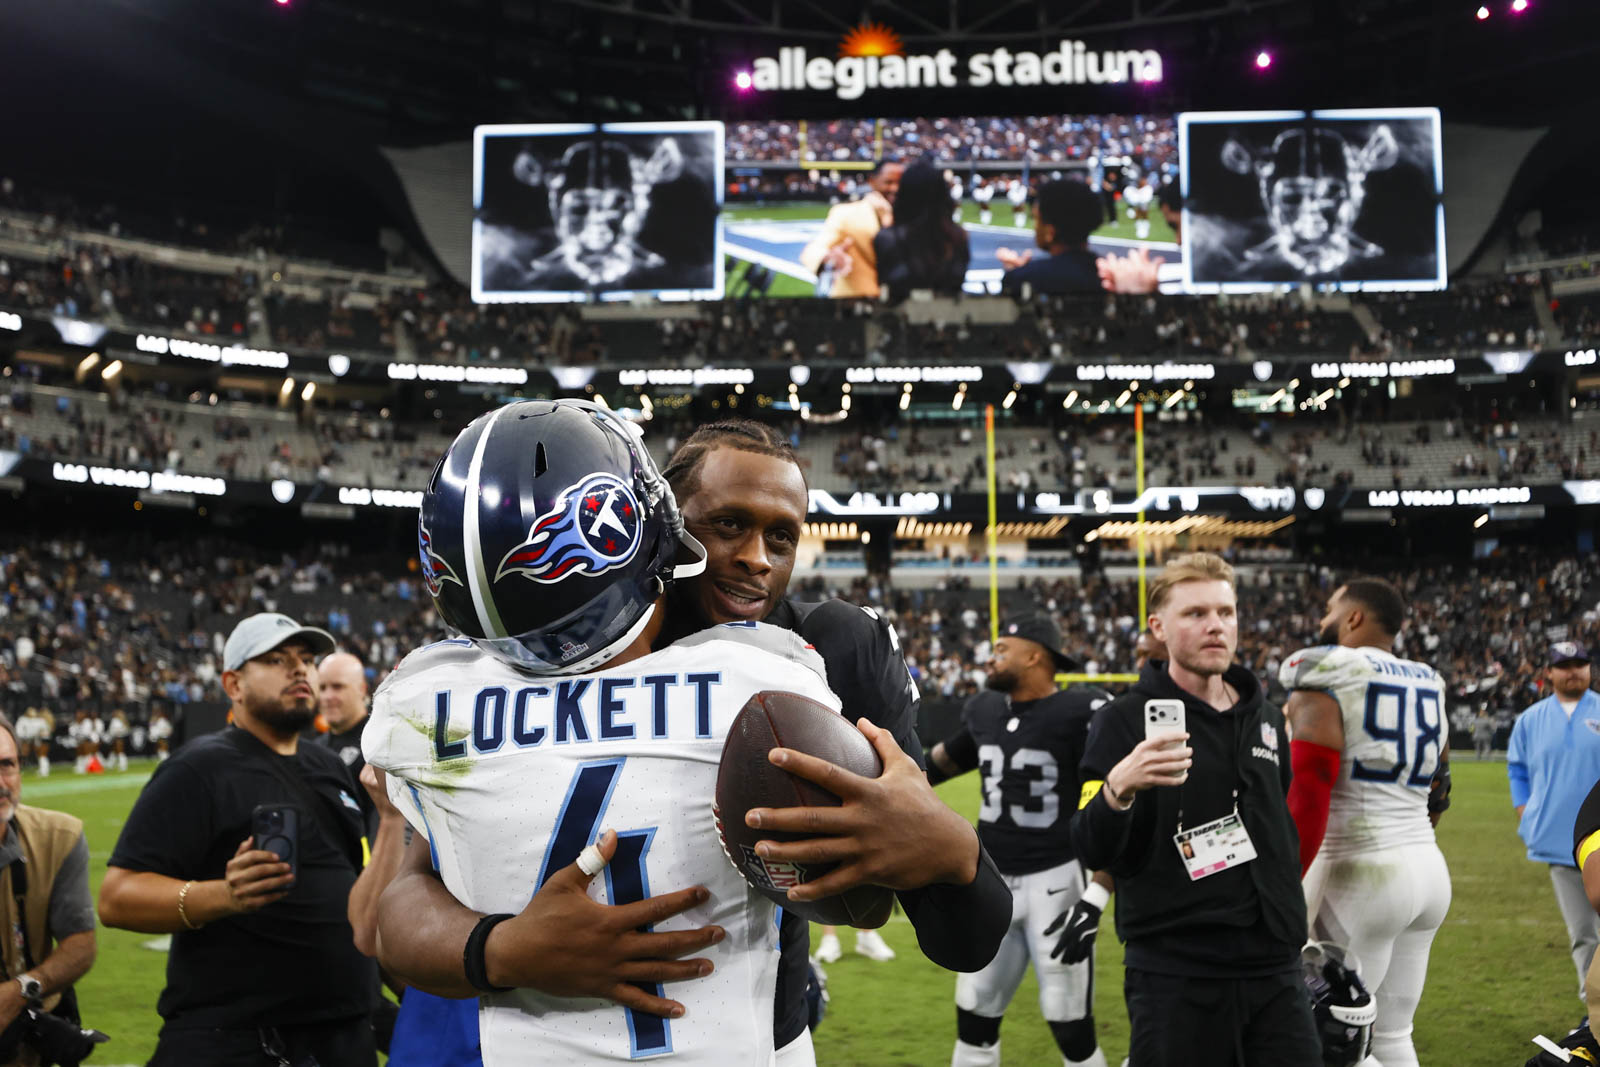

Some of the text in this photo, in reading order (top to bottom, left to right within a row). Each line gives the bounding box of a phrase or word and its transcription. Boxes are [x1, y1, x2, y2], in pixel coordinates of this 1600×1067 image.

[752, 40, 1164, 100] allegiant stadium
[433, 671, 722, 761] LOCKETT
[1351, 681, 1441, 788] 98
[978, 744, 1059, 829] 33
[531, 756, 674, 1059] 4
